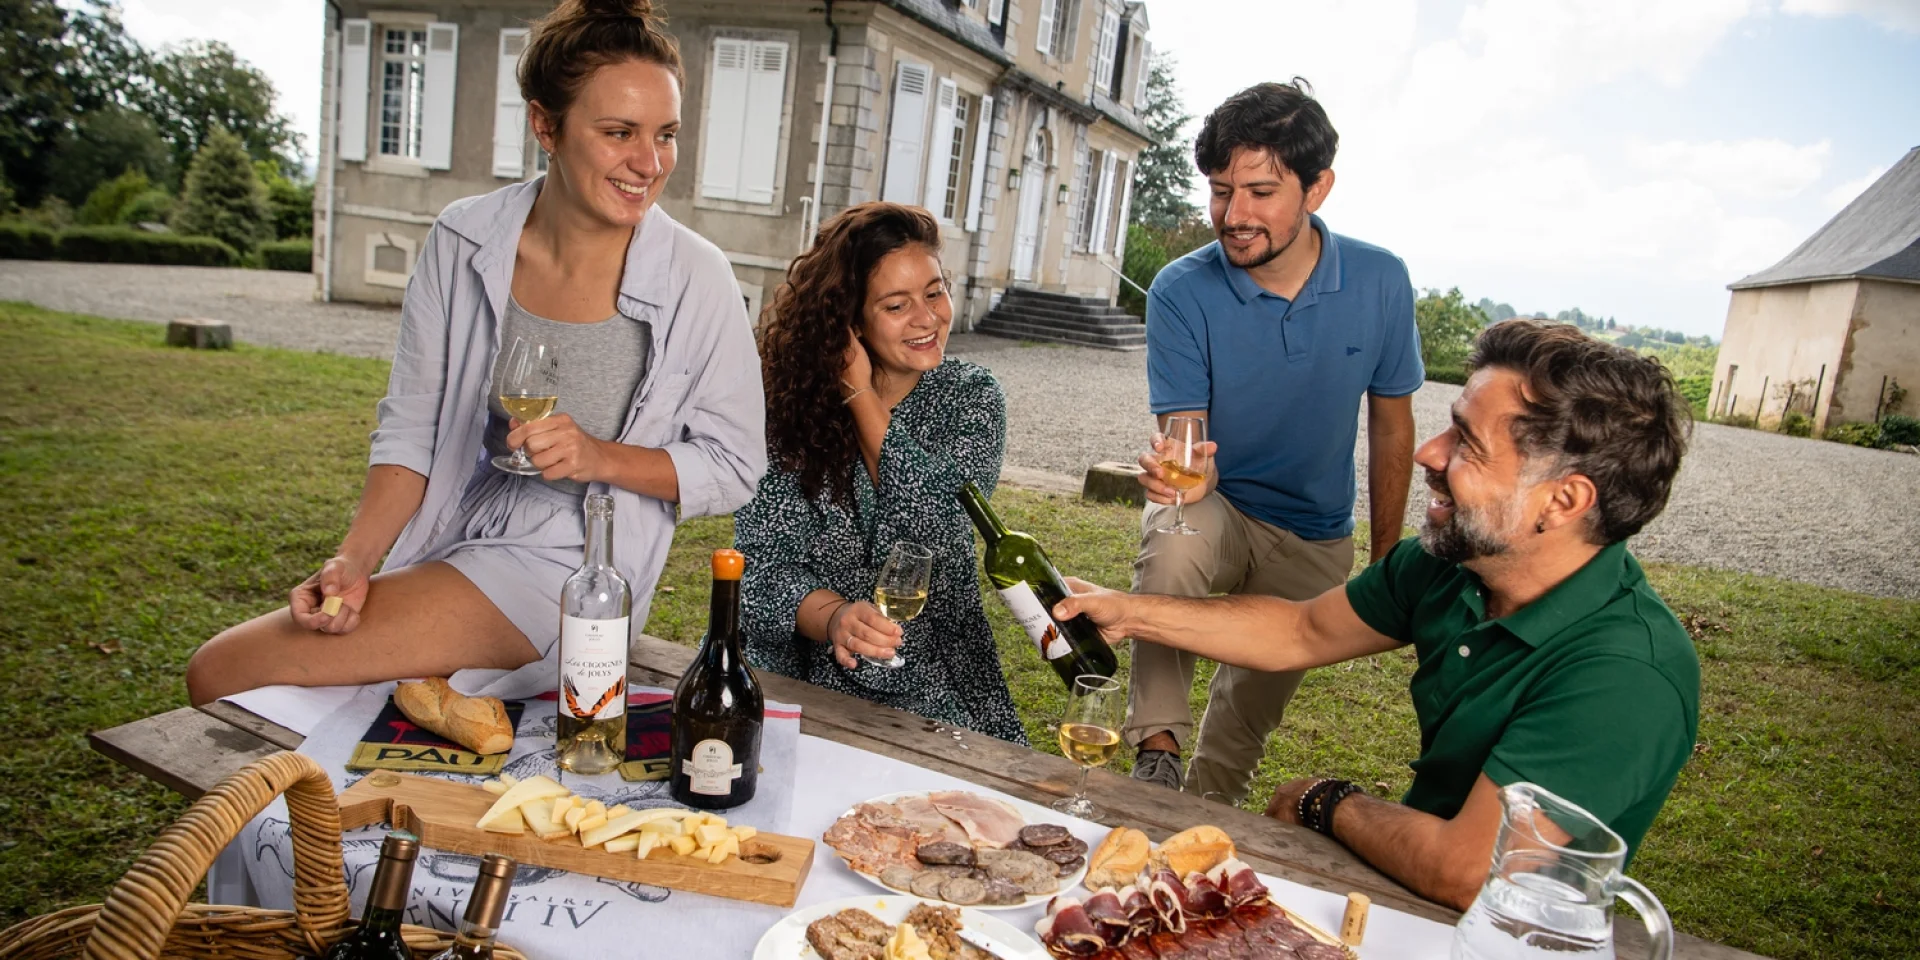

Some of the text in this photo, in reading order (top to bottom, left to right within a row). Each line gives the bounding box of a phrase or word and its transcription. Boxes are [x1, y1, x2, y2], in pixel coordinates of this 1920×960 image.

[588, 670, 611, 678] JOLYS
[376, 748, 484, 765] PAU
[540, 900, 613, 929] IV
